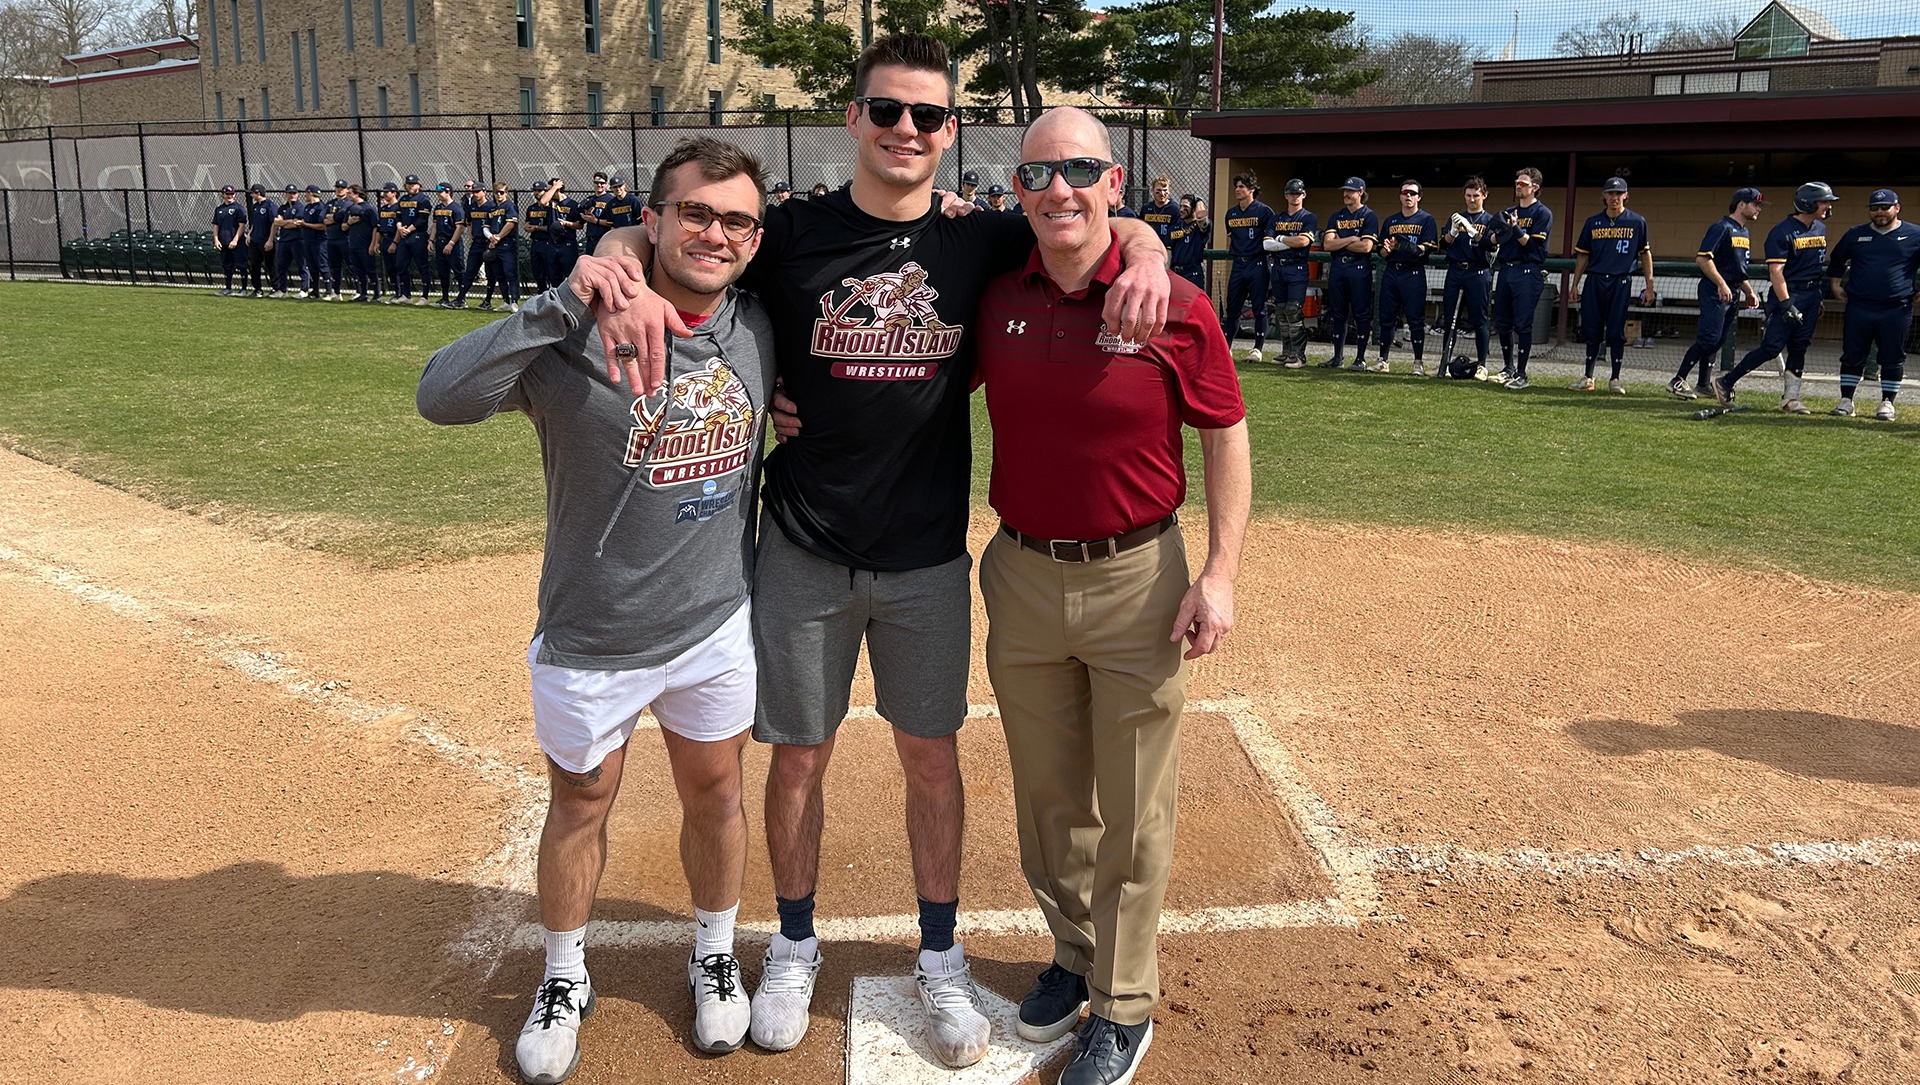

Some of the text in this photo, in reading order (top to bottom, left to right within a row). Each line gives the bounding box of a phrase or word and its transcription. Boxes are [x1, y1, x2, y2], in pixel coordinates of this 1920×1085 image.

[1160, 223, 1168, 236] 16
[1248, 227, 1255, 240] 8
[1388, 224, 1423, 235] MASSACHUSETTS
[1591, 227, 1634, 240] MASSACHUSETTS
[1615, 239, 1630, 254] 42
[815, 324, 961, 355] RHODE ISLAND
[843, 365, 926, 378] WRESTLING
